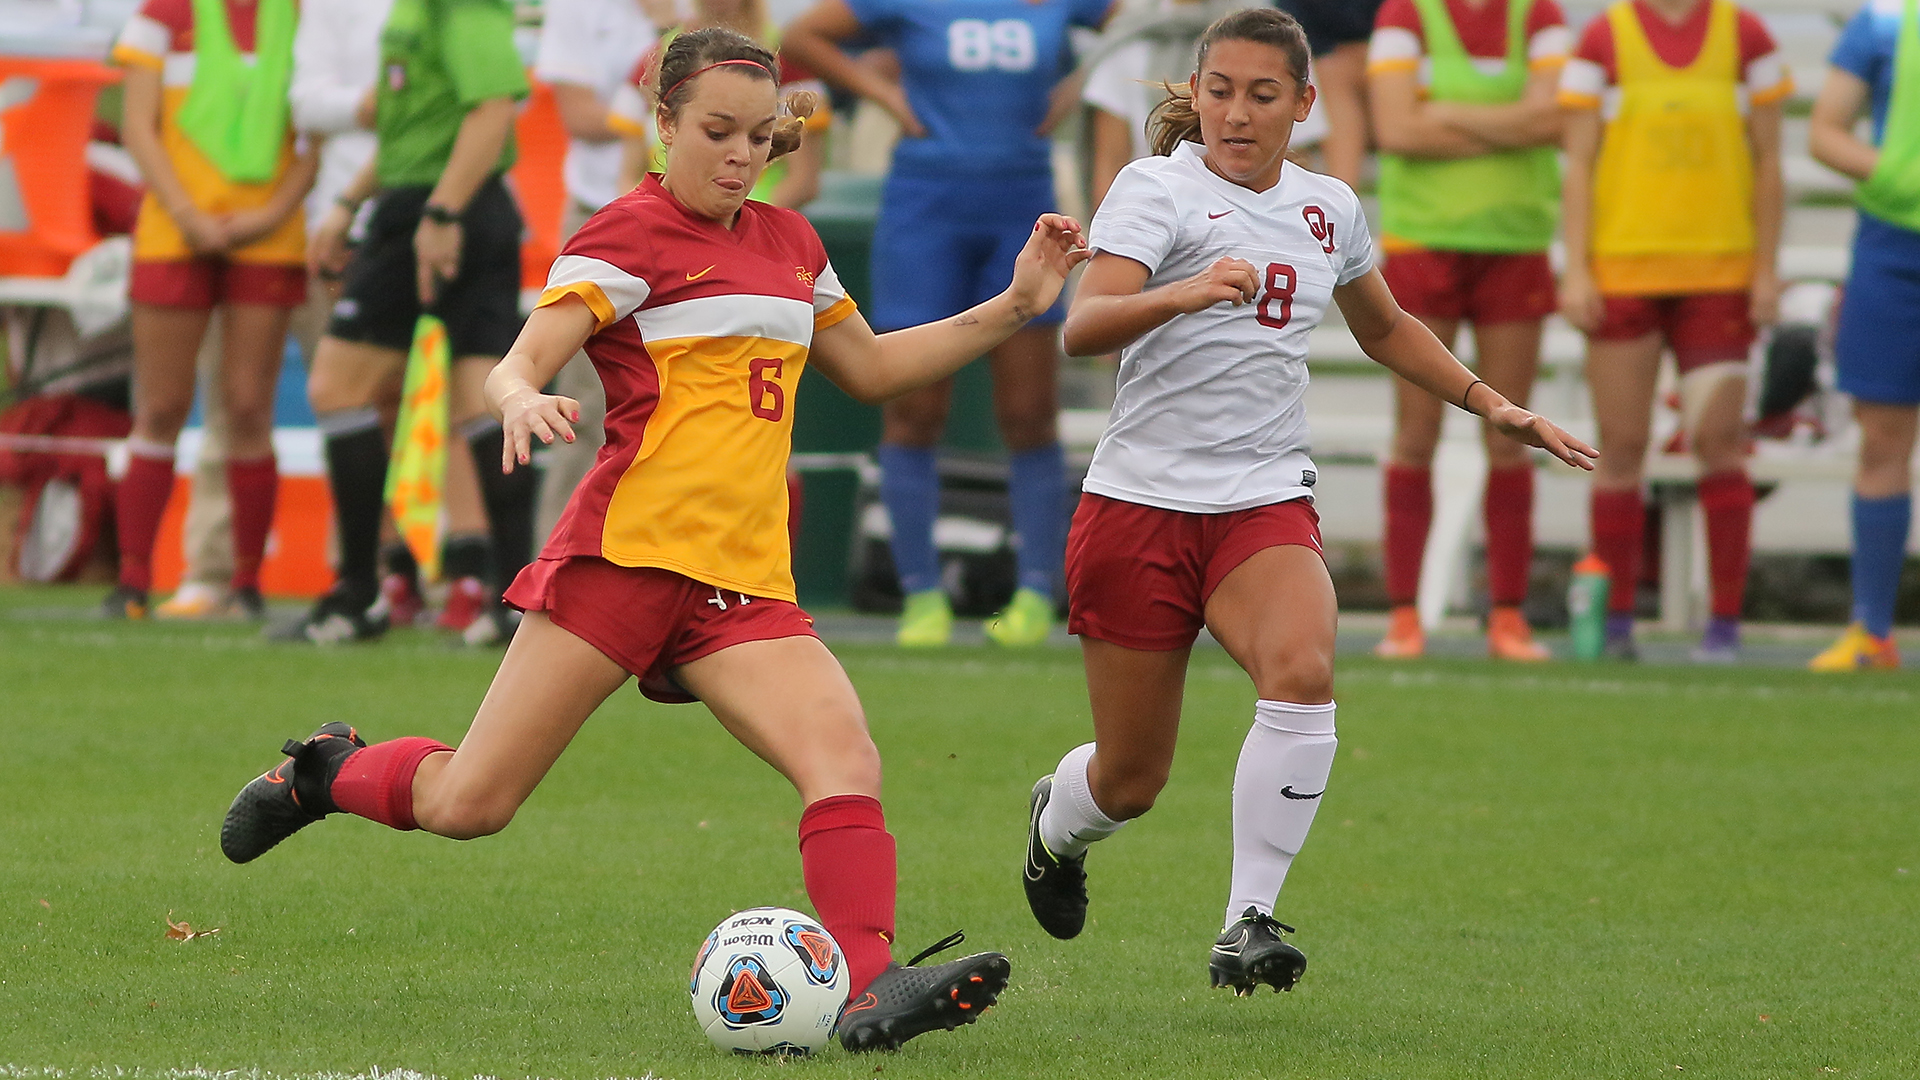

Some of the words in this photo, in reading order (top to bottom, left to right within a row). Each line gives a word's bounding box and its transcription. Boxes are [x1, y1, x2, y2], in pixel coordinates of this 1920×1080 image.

[948, 19, 1036, 70] 89
[1302, 205, 1335, 254] OU
[1256, 262, 1297, 329] 8
[748, 357, 784, 422] 6
[723, 934, 774, 946] Wilson
[731, 917, 775, 929] NCAA
